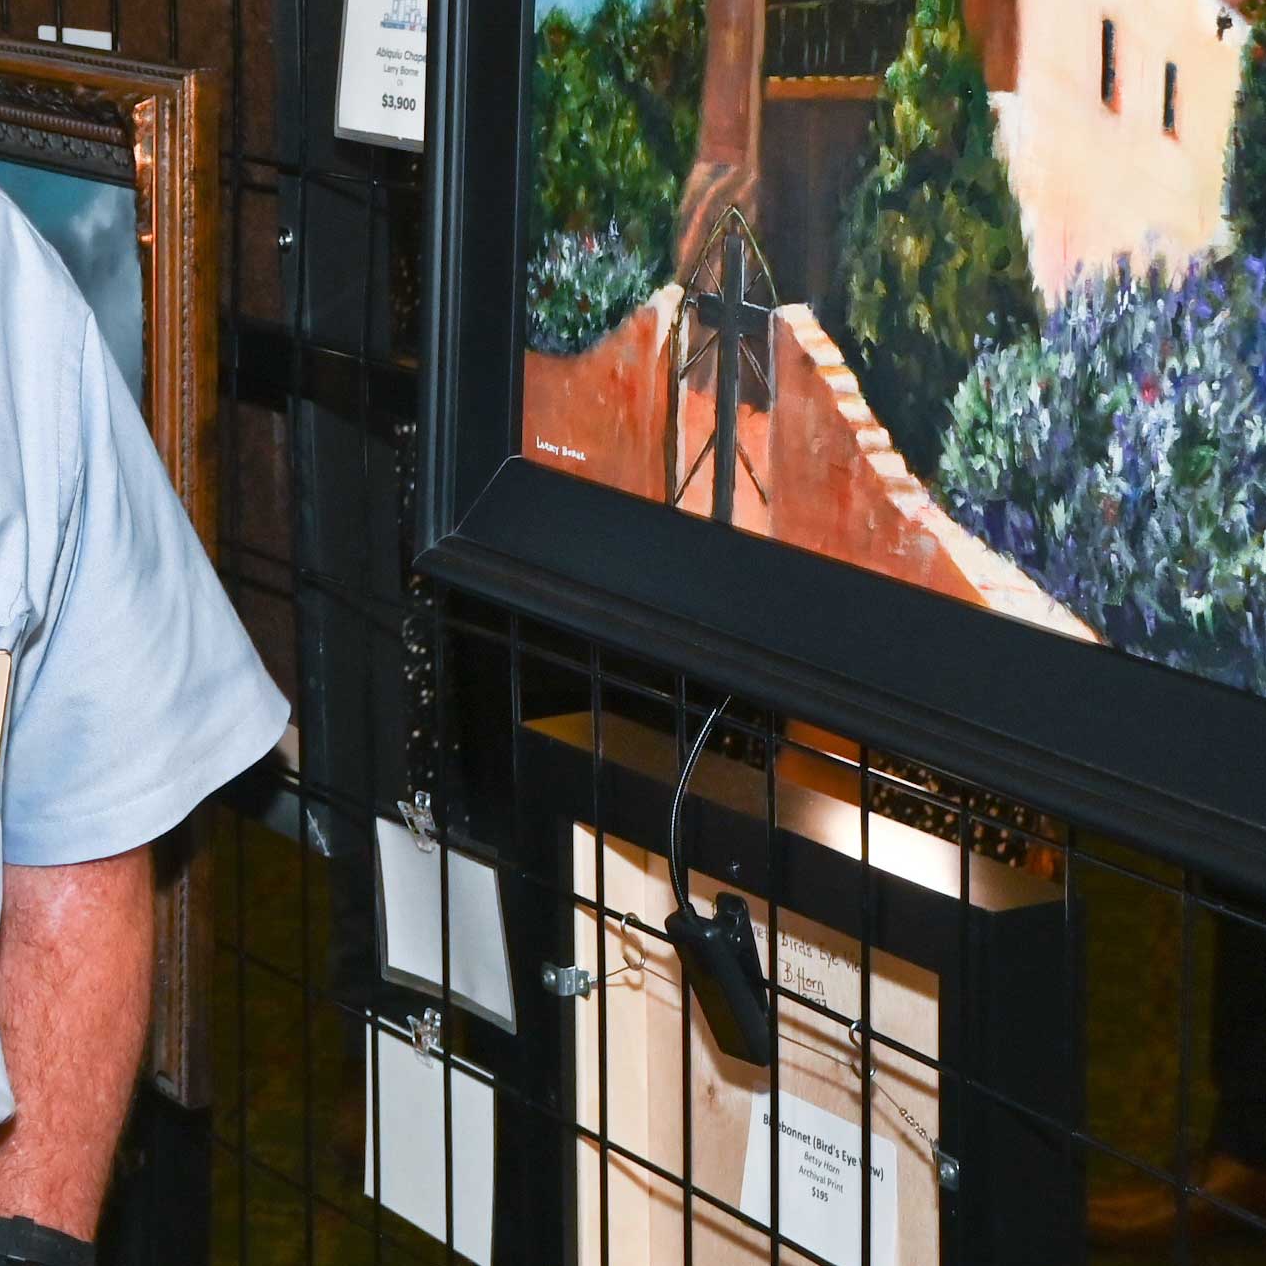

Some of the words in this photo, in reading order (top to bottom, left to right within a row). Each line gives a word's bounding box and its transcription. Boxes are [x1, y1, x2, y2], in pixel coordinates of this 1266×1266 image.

[404, 50, 426, 63] Chape
[384, 64, 398, 76] Larry
[381, 94, 416, 111] $3,900
[797, 967, 825, 996] Horn
[763, 1113, 811, 1146] Bebonnet
[813, 1136, 840, 1159] (Bird's
[841, 1150, 857, 1167] Eye
[859, 1157, 884, 1182] Vw)
[804, 1151, 822, 1168] Betsy
[823, 1162, 840, 1175] Horn
[799, 1165, 826, 1184] Archival
[827, 1177, 844, 1193] Print
[812, 1186, 829, 1203] $195
